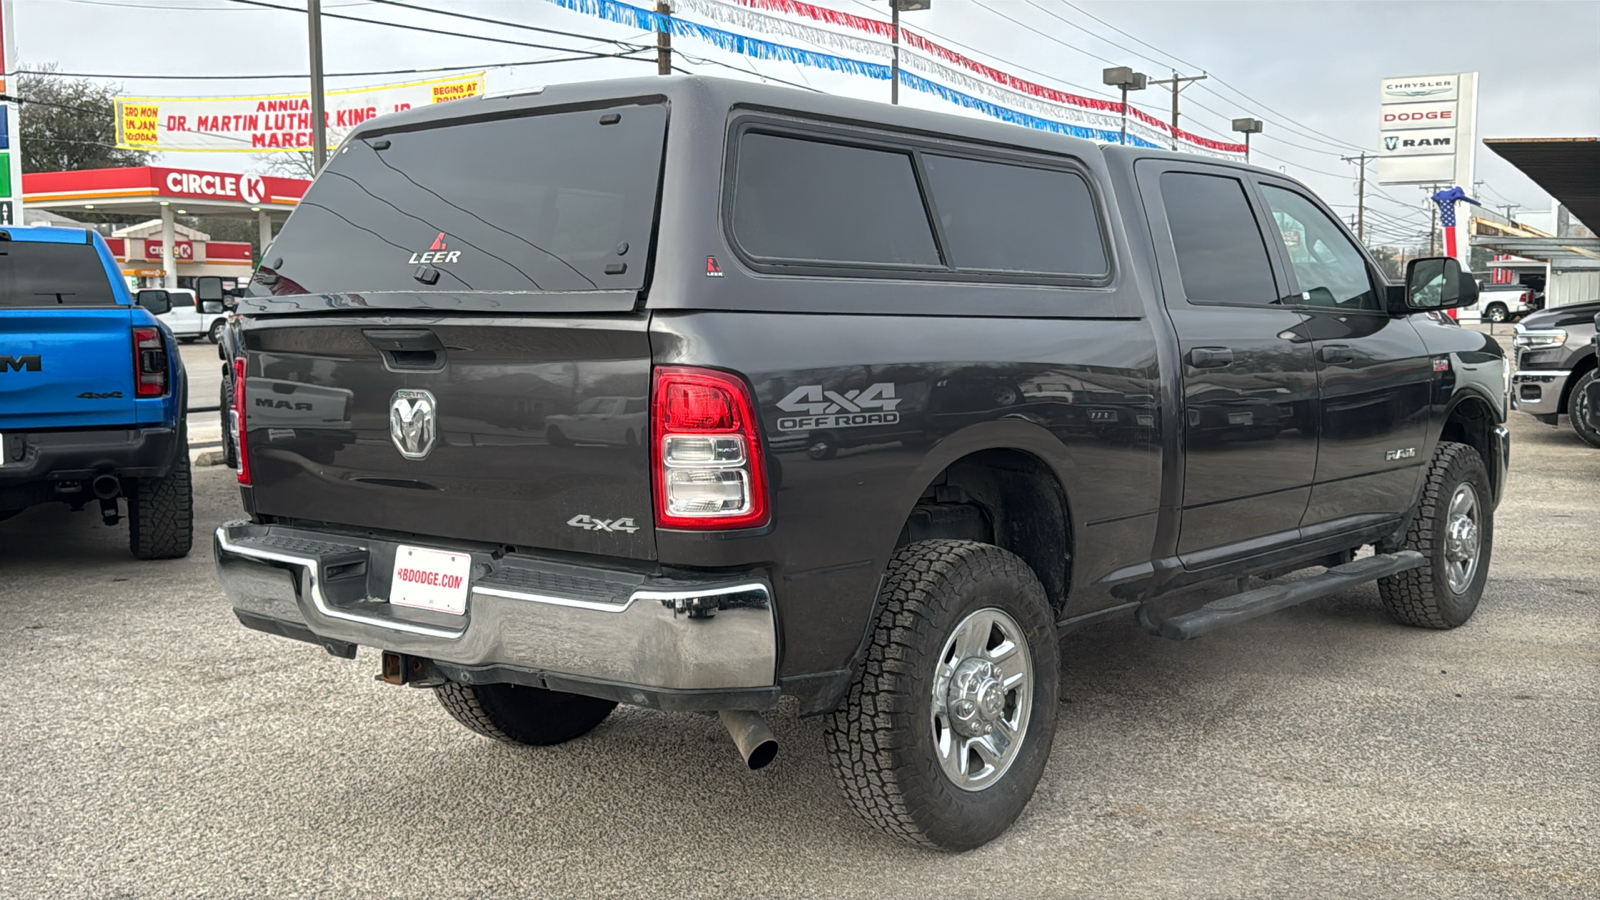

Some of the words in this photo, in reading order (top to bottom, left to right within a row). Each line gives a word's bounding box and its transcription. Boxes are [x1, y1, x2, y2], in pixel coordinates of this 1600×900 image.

[433, 85, 464, 96] BEGINS
[467, 83, 477, 92] AT
[1386, 81, 1451, 90] CHRYSLER
[256, 99, 309, 112] ANNUA
[141, 108, 158, 118] MON
[167, 115, 191, 132] DR.
[197, 114, 259, 132] MARTIN
[336, 106, 377, 127] KING
[1384, 111, 1452, 122] DODGE
[1403, 138, 1451, 147] RAM
[166, 172, 237, 196] CIRCLE
[408, 250, 461, 264] LEER
[779, 416, 831, 430] OFF
[834, 413, 898, 426] ROAD
